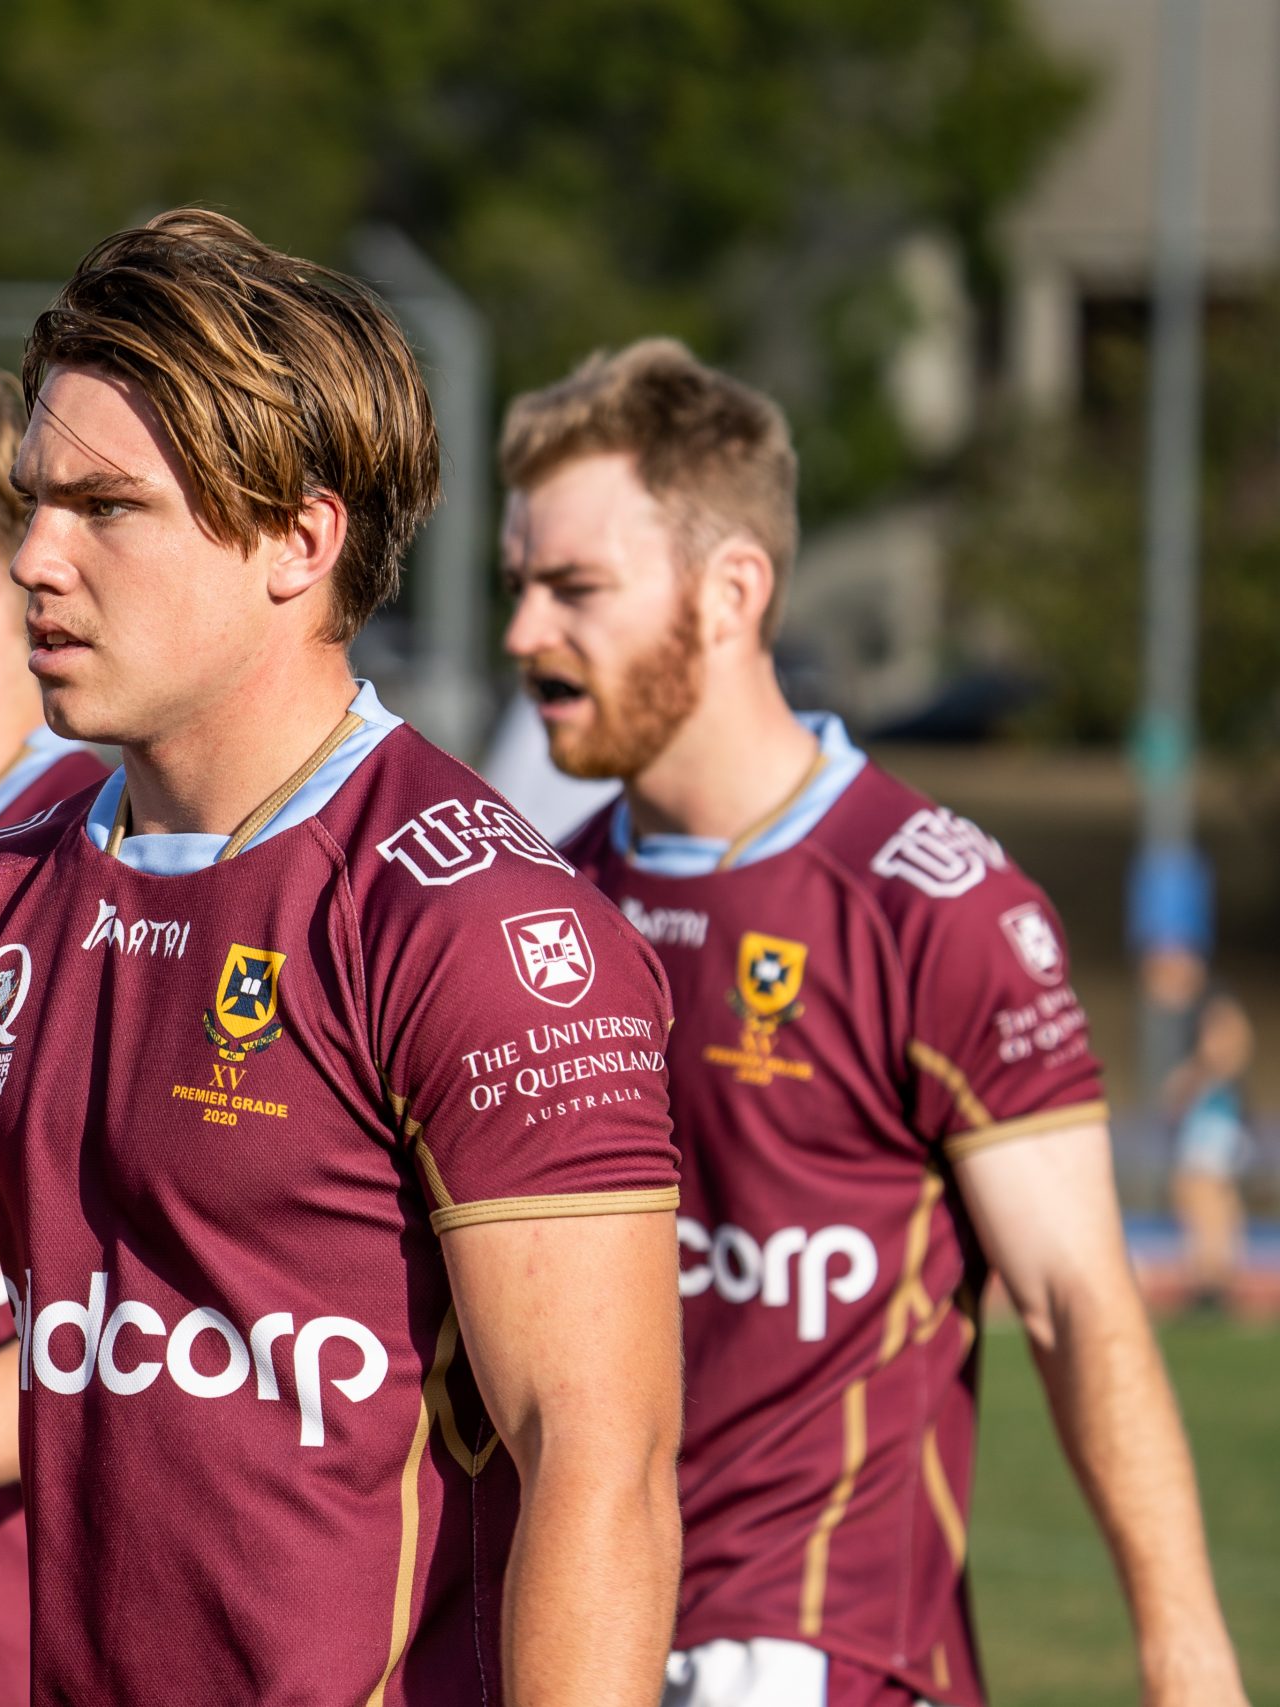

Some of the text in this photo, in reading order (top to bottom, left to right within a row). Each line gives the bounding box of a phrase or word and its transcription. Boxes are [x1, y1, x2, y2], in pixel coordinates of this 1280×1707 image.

[457, 827, 512, 841] TEAM
[81, 899, 190, 959] MATAI
[462, 1016, 652, 1079] THE UNIVERSITY
[209, 1064, 247, 1091] XV
[470, 1082, 508, 1111] OF
[515, 1051, 665, 1098] QUEENSLAND
[172, 1085, 288, 1119] PREMIER GRADE
[203, 1108, 238, 1127] 2020
[524, 1088, 642, 1127] AUSTRALIA
